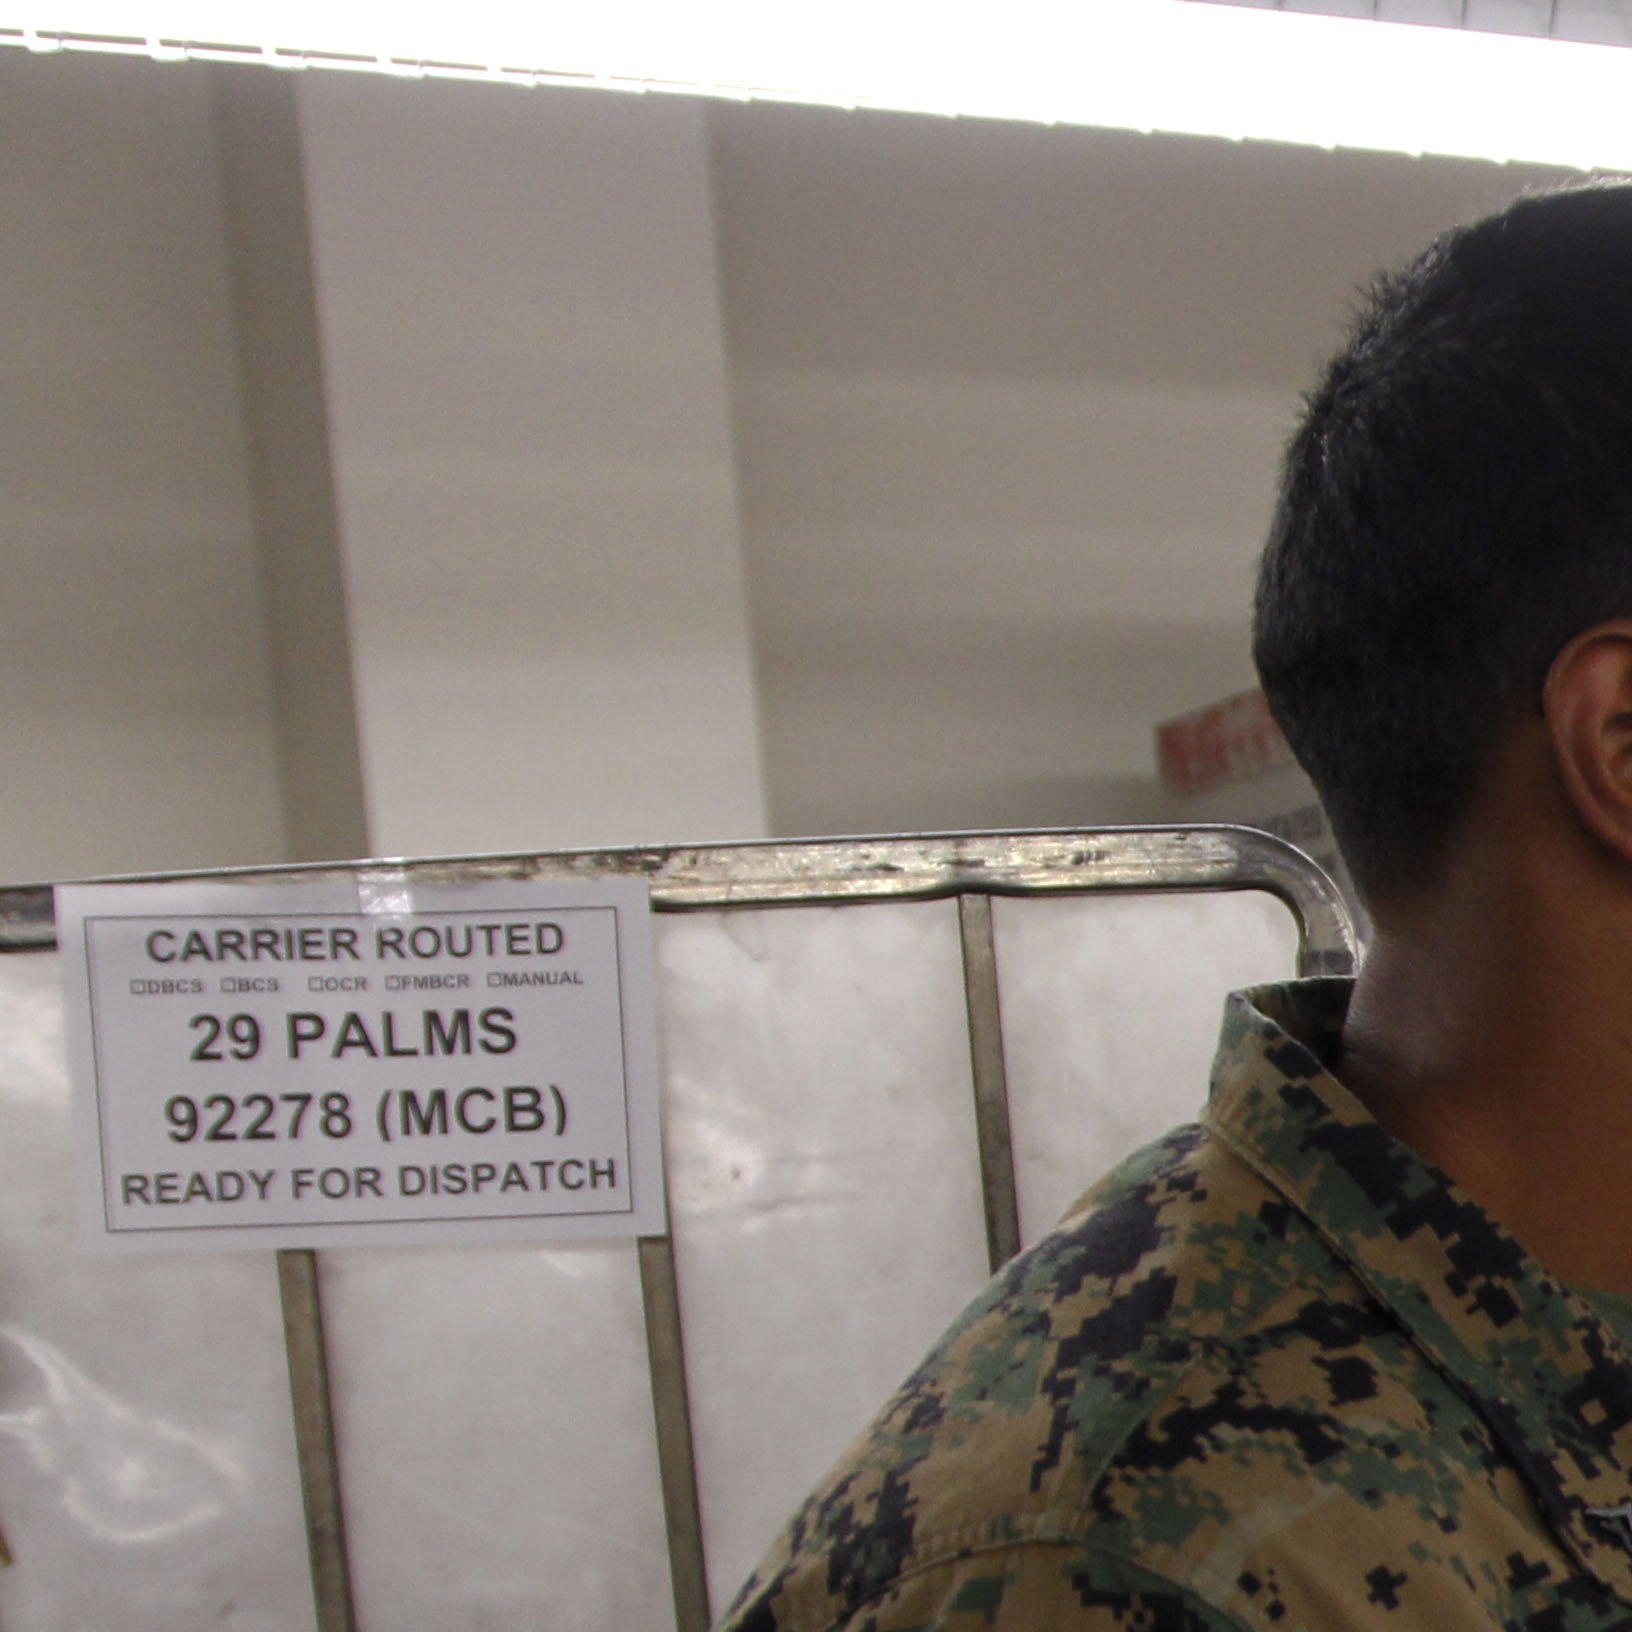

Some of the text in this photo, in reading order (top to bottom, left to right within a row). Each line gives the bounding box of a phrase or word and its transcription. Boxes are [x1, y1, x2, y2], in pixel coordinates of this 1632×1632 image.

[146, 922, 564, 963] CARRIER ROUTED
[147, 970, 584, 994] DBCS BCS OCR FMBCR MANUAL
[189, 1006, 517, 1060] 29 PALMS
[164, 1084, 567, 1142] 92278 (MCB)
[121, 1157, 617, 1205] READY FOR DISPATCH
